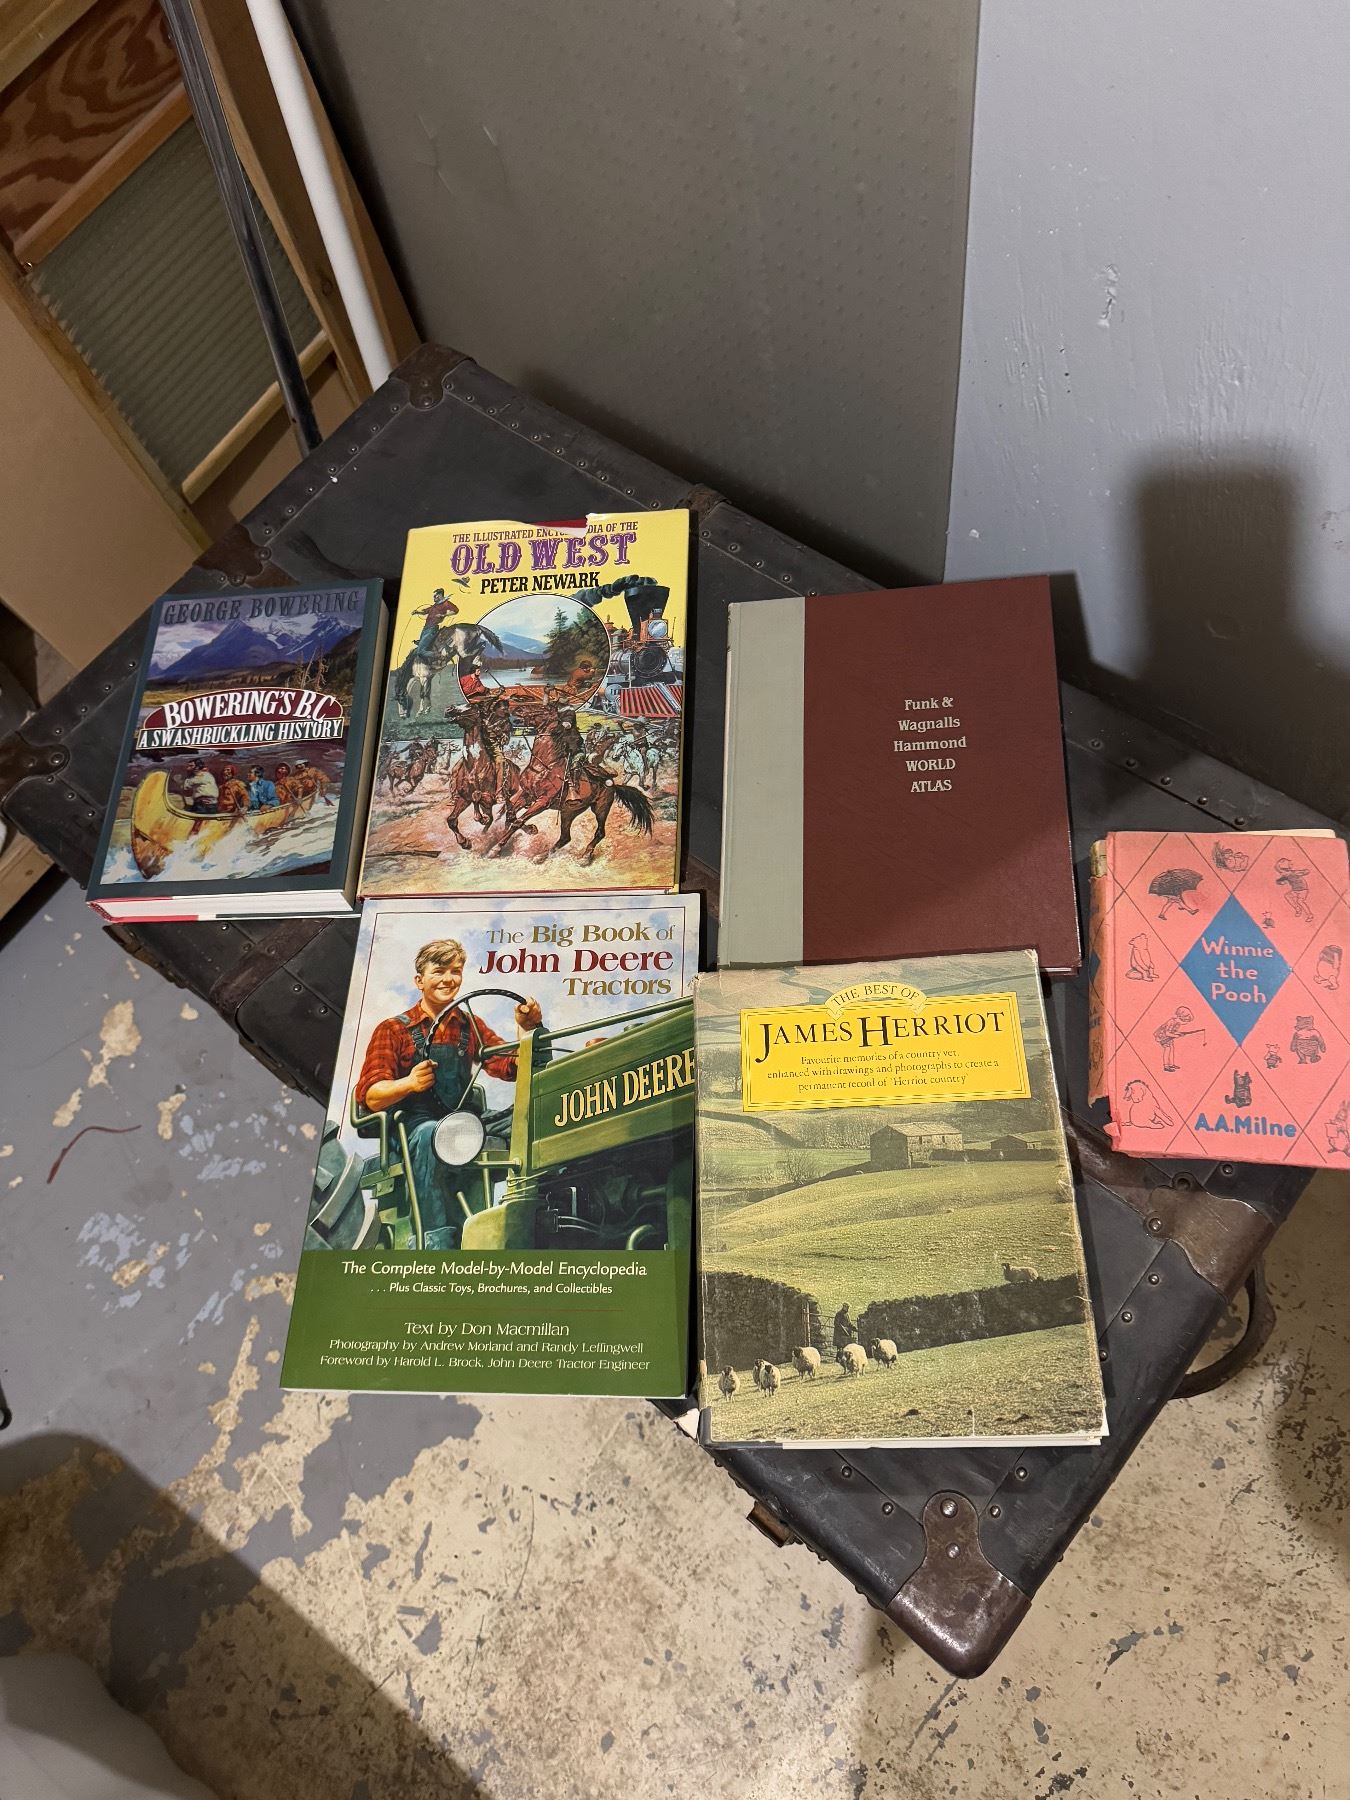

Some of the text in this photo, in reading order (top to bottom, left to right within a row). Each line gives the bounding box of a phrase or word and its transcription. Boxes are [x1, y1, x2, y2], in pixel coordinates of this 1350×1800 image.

[452, 533, 471, 543] THE
[473, 528, 534, 542] ILLUSTRATED
[606, 522, 617, 533] OF
[619, 521, 639, 531] THE
[450, 532, 637, 577] OLD WEST
[480, 571, 600, 594] PETER NEWARK
[163, 589, 360, 625] GEORGE BOWERING
[163, 690, 296, 730] BOWERING'S
[904, 696, 954, 711] Funk &
[138, 719, 343, 748] A SWASHBUCKLING HISTORY
[897, 716, 961, 733] Wagnalls
[893, 736, 967, 752] Hammond
[905, 758, 956, 772] WORLD
[910, 779, 953, 793] ATLAS
[486, 922, 676, 947] The Big Book of
[1201, 935, 1274, 958] Winnie
[479, 948, 674, 974] John Deere
[1216, 961, 1258, 980] the
[562, 978, 672, 997] Tractors
[830, 984, 919, 1007] THE BEST OF
[1211, 982, 1266, 1003] Pooh
[755, 1011, 1005, 1063] JAMES HERRIOT
[843, 1053, 886, 1063] memories
[888, 1051, 898, 1061] of
[905, 1050, 941, 1061] country
[767, 1067, 810, 1079] enhanced
[811, 1067, 832, 1076] with
[832, 1065, 874, 1077] drawings
[876, 1064, 893, 1073] and
[894, 1061, 952, 1075] photographs
[953, 1061, 963, 1069] to
[964, 1060, 993, 1069] create
[554, 1047, 695, 1127] JOHN DEERE
[798, 1082, 846, 1094] permanent
[848, 1078, 876, 1089] record
[877, 1076, 888, 1087] of
[342, 1260, 648, 1280] The Complete Model-by-Model Encyclopedia
[389, 1282, 411, 1293] Plus
[412, 1282, 447, 1293] Classic
[449, 1282, 475, 1296] Toys,
[477, 1282, 531, 1295] Brochures,
[533, 1283, 553, 1293] and
[556, 1284, 613, 1294] Collectibles
[404, 1322, 570, 1337] Text by Don Macmillan
[329, 1339, 643, 1355] Photography by Andrew Morland and Randy Leffingwell
[320, 1355, 373, 1366] Foreword
[376, 1356, 391, 1368] by
[394, 1356, 431, 1367] Harold
[434, 1358, 445, 1367] L.
[487, 1358, 515, 1368] John
[518, 1359, 553, 1369] Deere
[556, 1359, 597, 1369] Tractor
[599, 1360, 651, 1371] Engineer
